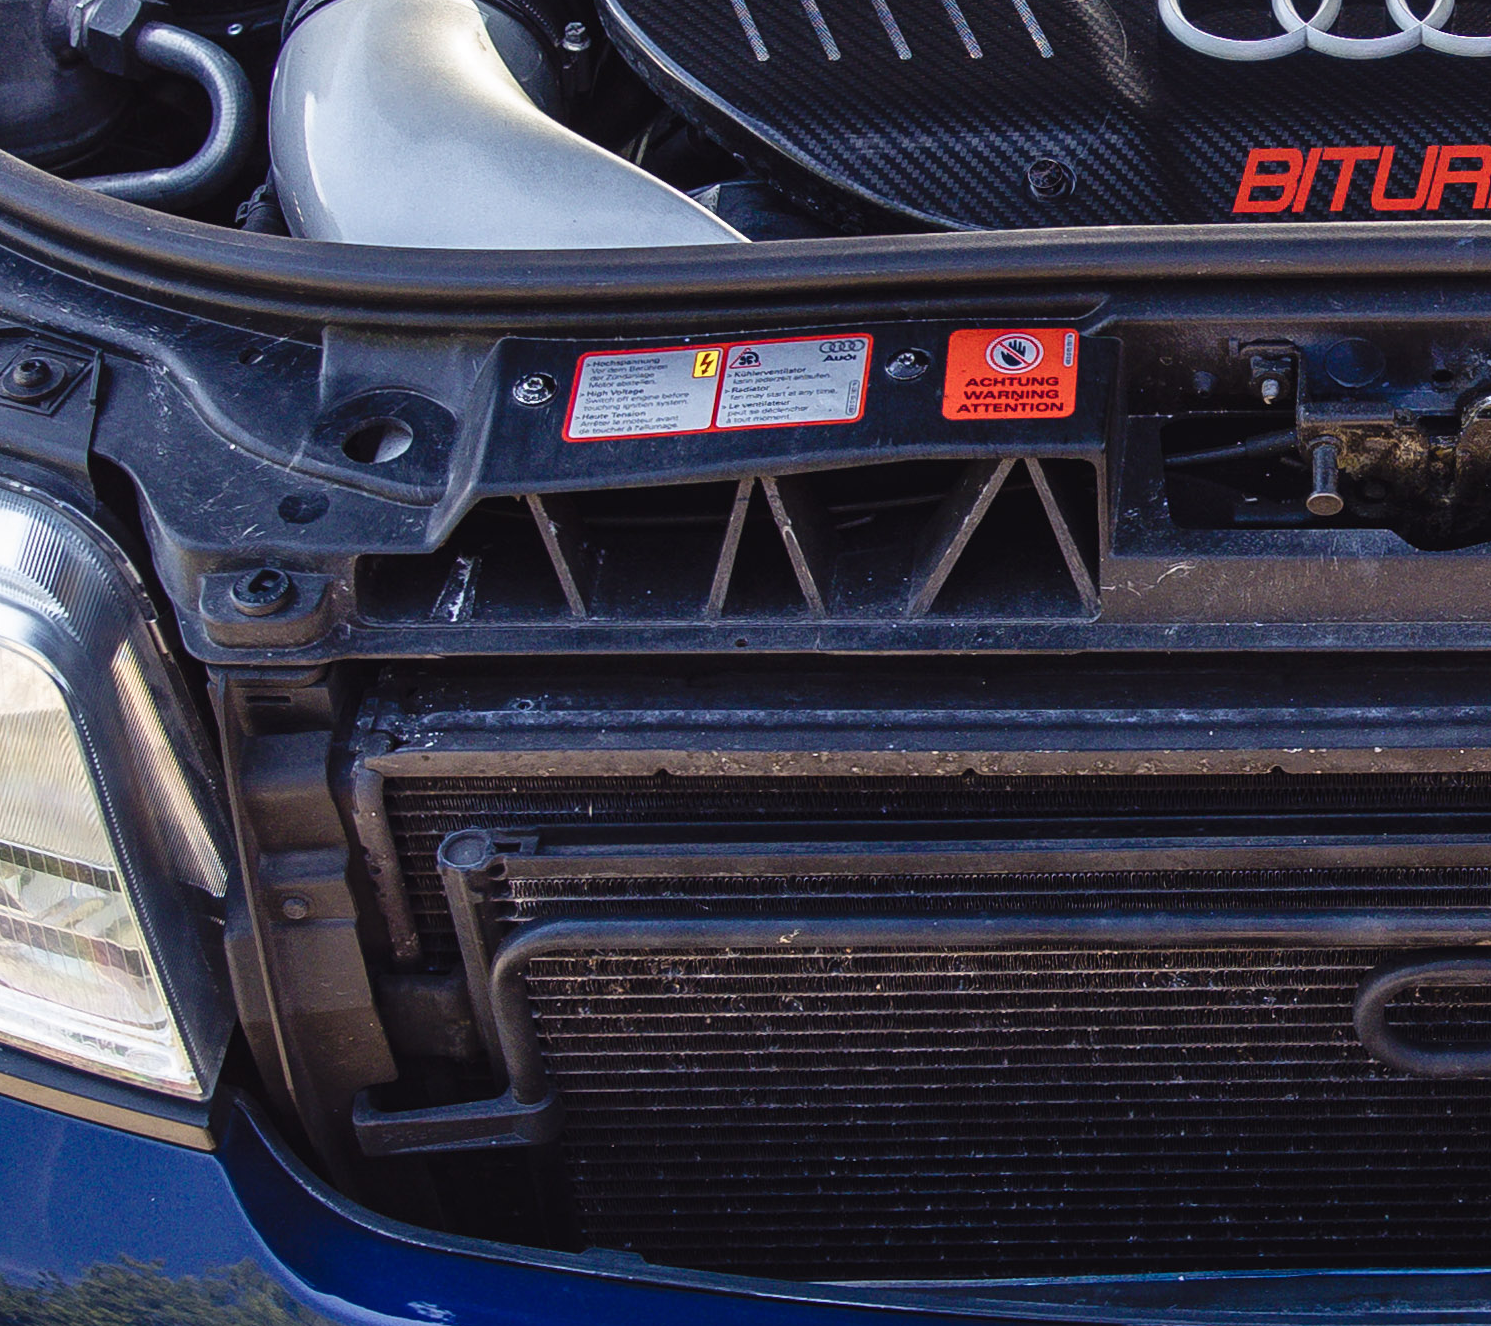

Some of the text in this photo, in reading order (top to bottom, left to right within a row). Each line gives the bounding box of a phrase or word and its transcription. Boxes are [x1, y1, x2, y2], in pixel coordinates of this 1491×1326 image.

[592, 358, 660, 367] Hochspannung
[823, 354, 857, 362] Audi
[734, 367, 807, 377] Kühlerventilator
[965, 377, 1059, 387] ACHTUNG
[731, 385, 770, 393] Radiator
[745, 393, 764, 401] may
[964, 390, 1059, 400] WARNING
[957, 403, 1063, 413] ATTENTION
